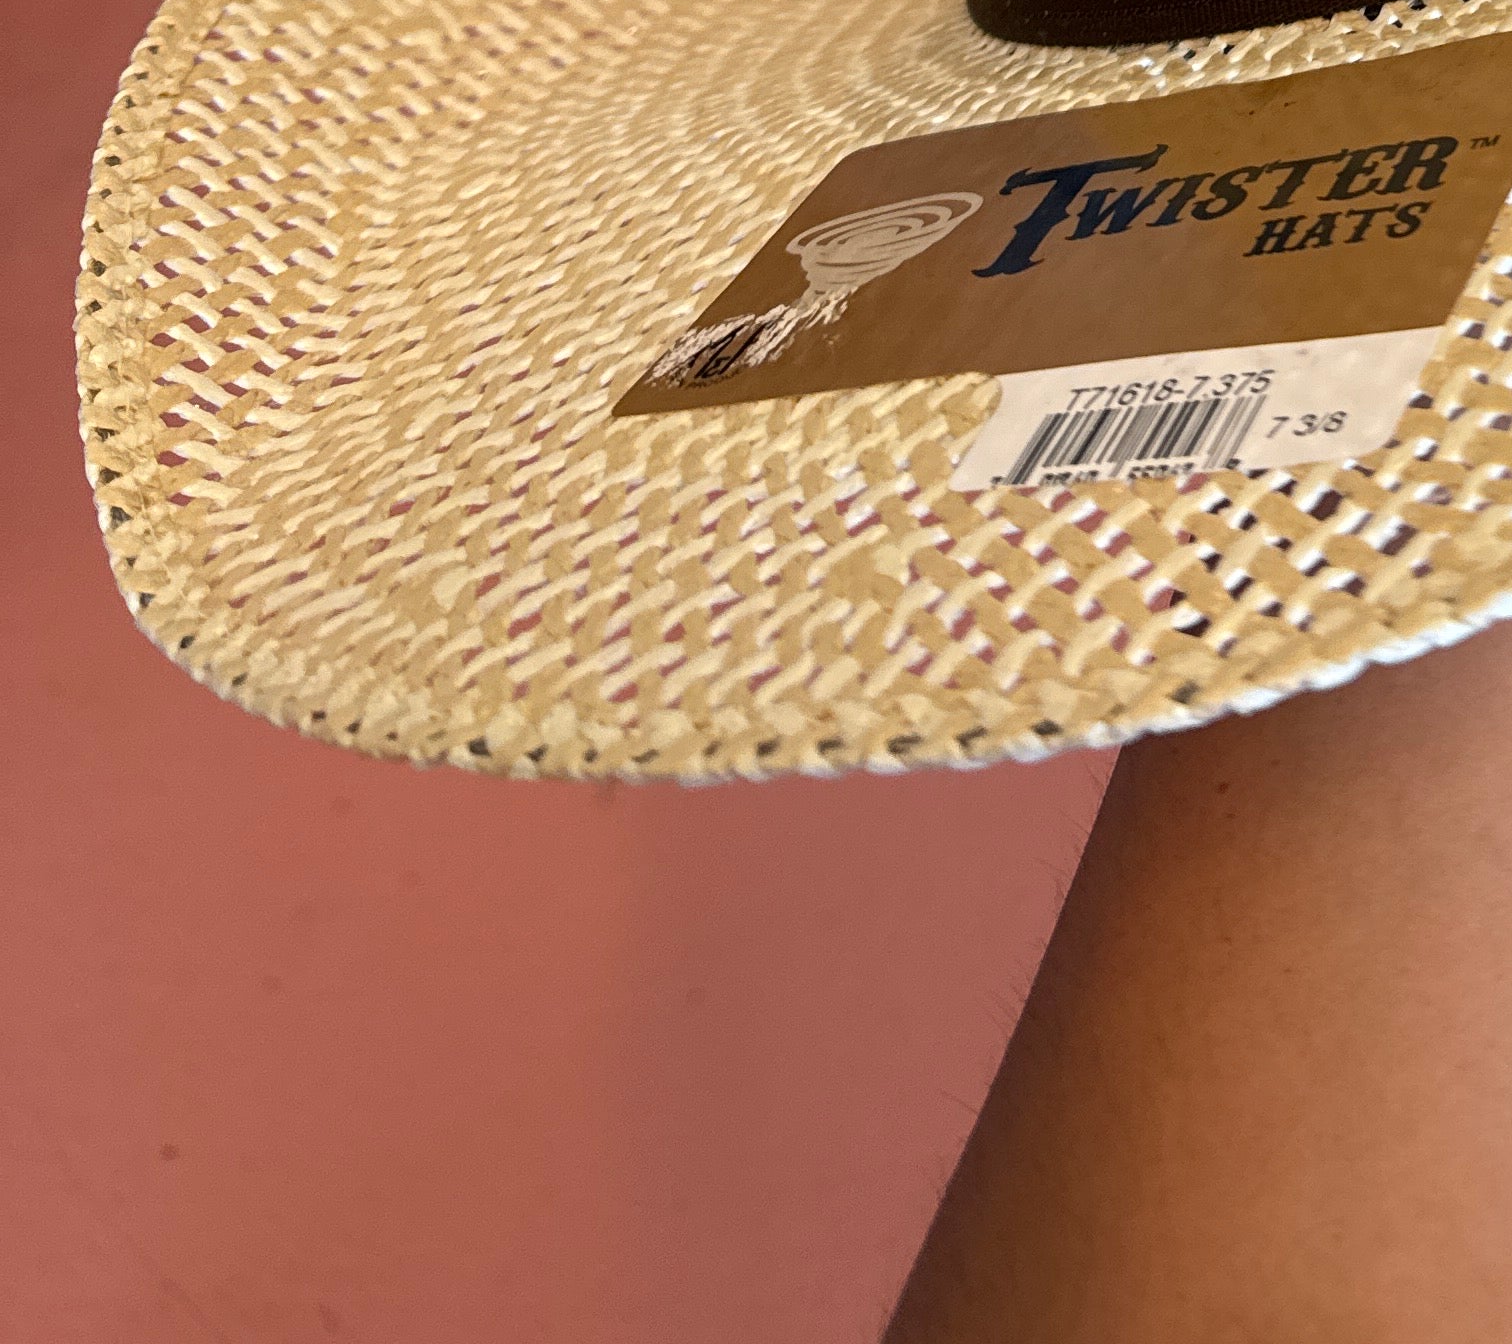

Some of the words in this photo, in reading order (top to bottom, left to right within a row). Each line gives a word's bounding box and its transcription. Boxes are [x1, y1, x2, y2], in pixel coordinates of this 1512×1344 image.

[971, 135, 1459, 278] TWISTER
[1243, 201, 1432, 257] HATS
[1067, 370, 1275, 411] T71618-7.375
[1265, 416, 1288, 438] 7
[1294, 411, 1347, 436] 3/8
